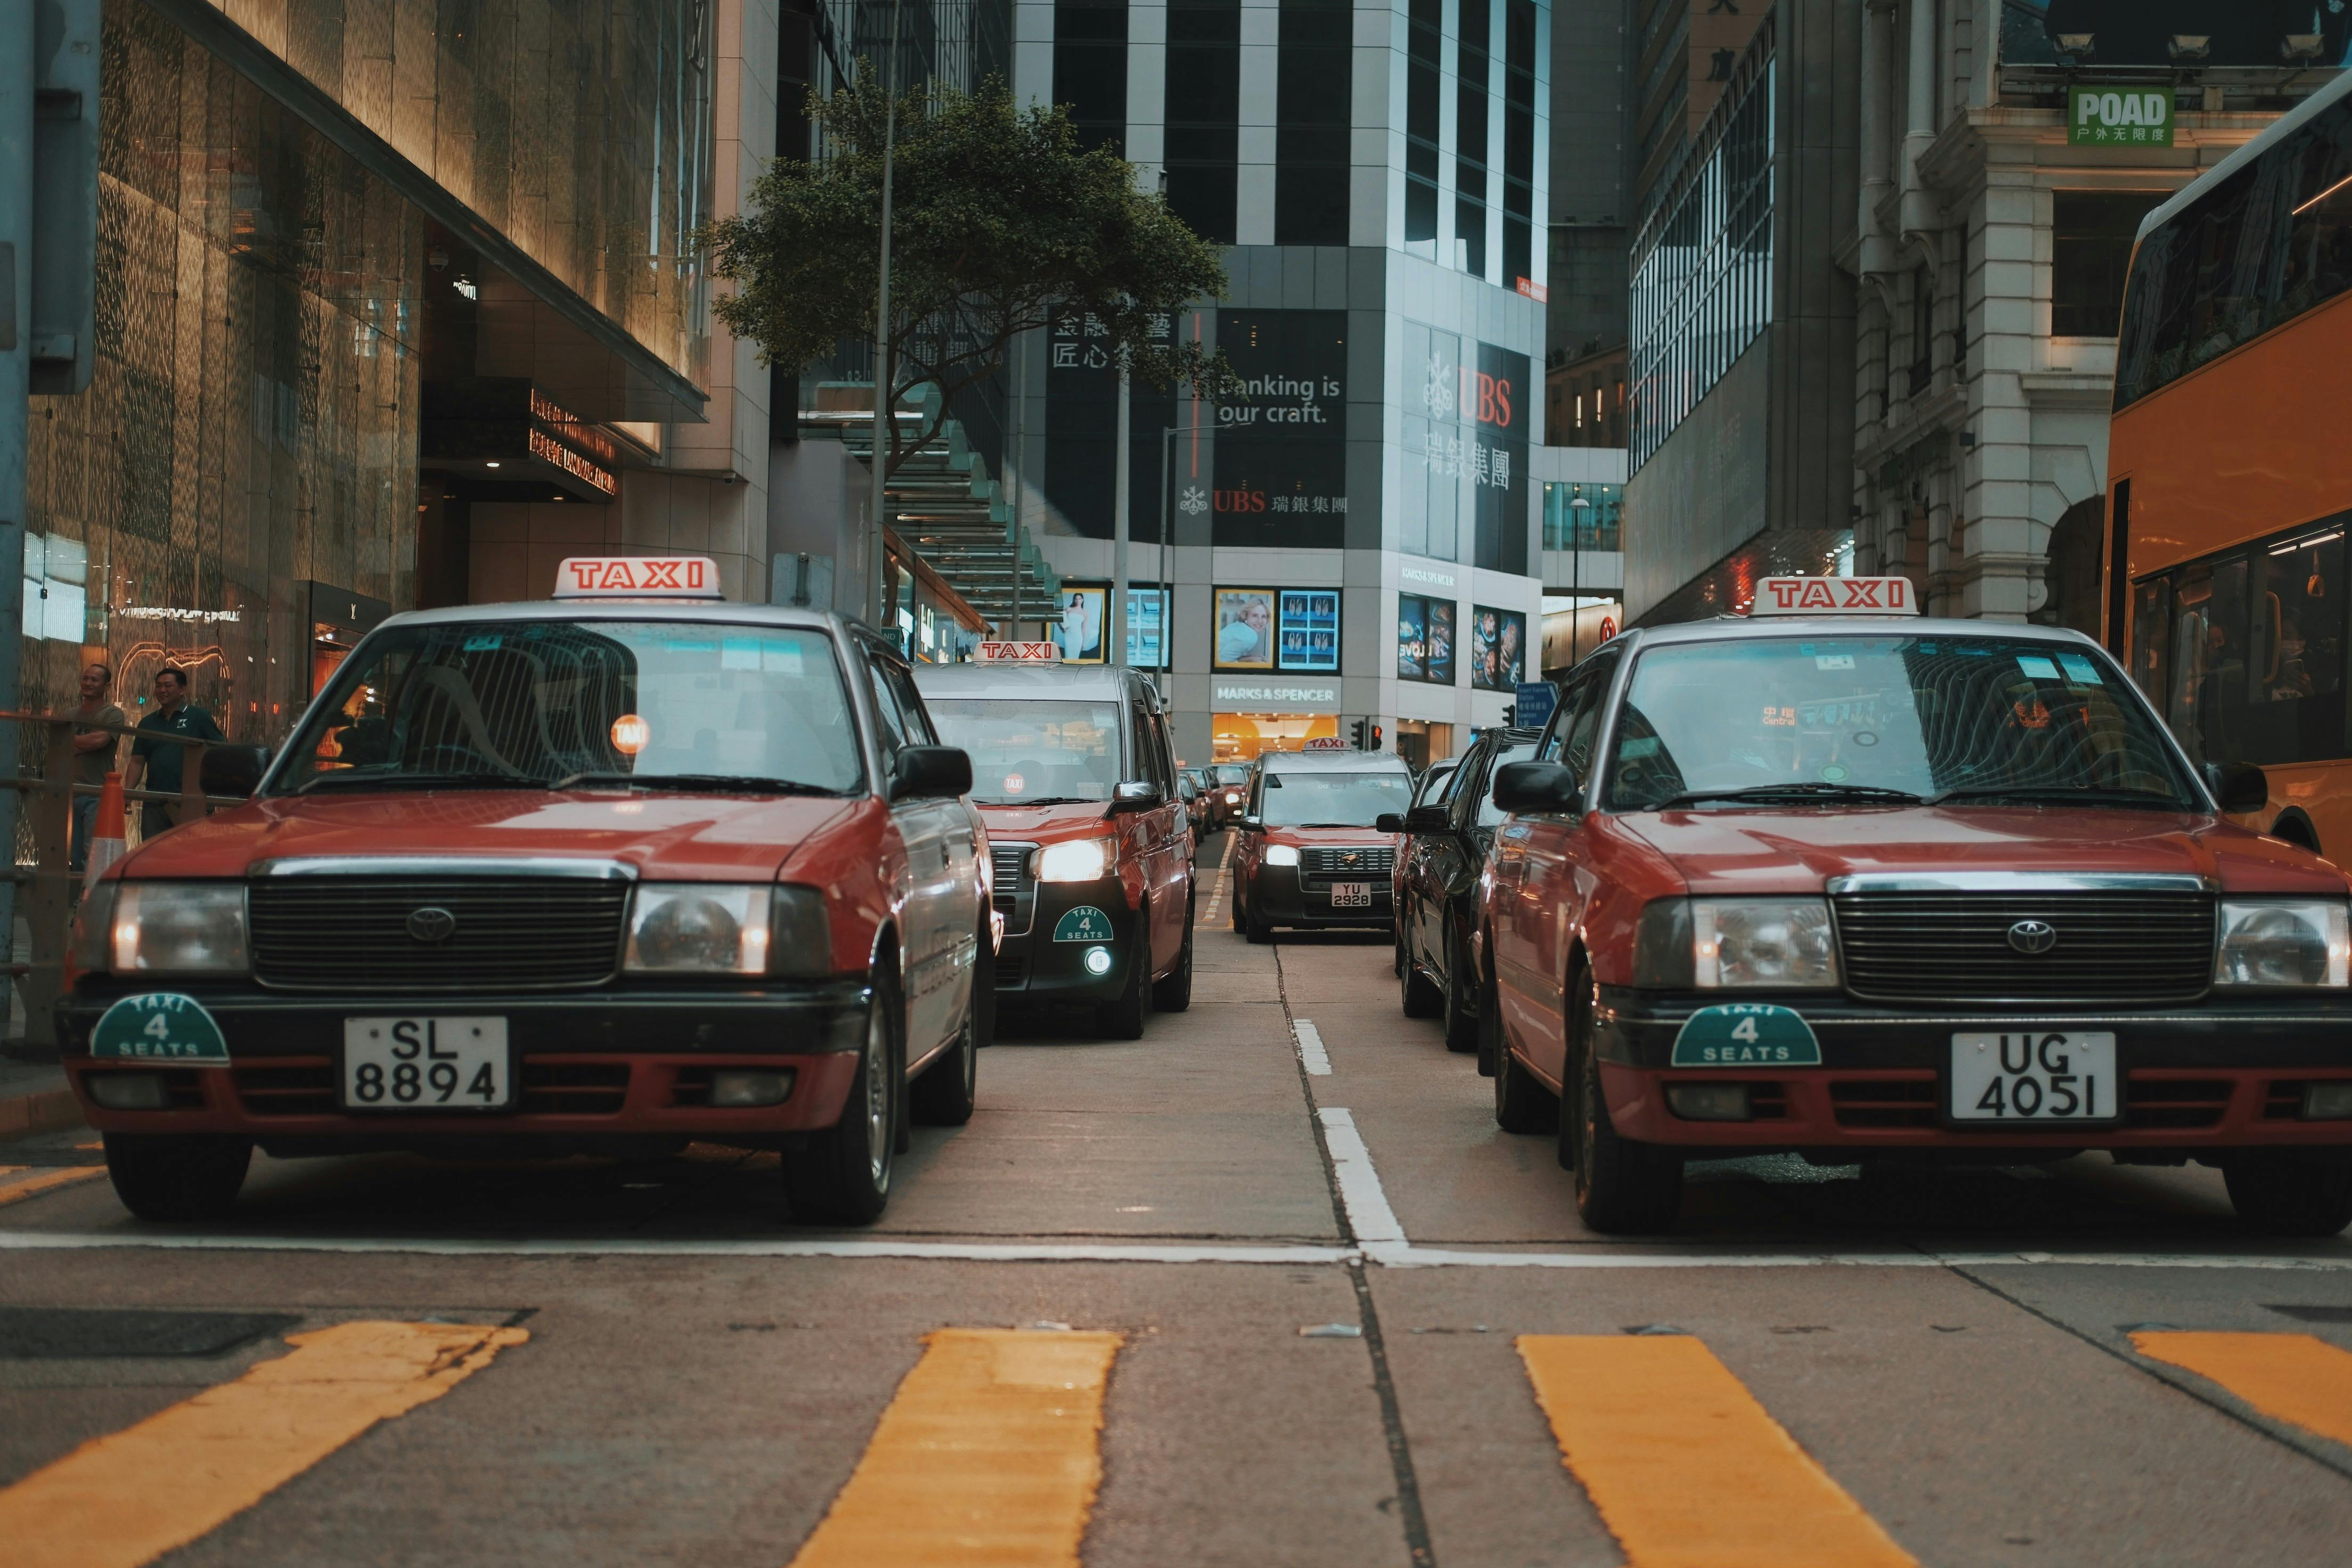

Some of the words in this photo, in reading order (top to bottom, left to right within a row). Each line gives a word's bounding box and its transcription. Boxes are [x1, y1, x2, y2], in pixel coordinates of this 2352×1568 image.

[2078, 93, 2166, 126] POAD
[1322, 375, 1340, 396] is
[1458, 366, 1511, 428] UBS
[1219, 406, 1260, 422] our
[1265, 401, 1327, 423] craft.
[1213, 490, 1265, 512] UBS
[1271, 495, 1348, 513] 瑞銀集團
[569, 561, 703, 589] TAXI
[1768, 580, 1904, 608] TAXI
[982, 642, 1052, 659] TAXI
[1218, 687, 1262, 700] MARKS
[1263, 688, 1273, 700] &
[1273, 688, 1334, 701] SPENCER
[1762, 716, 1795, 726] Central
[614, 724, 647, 744] TAXI
[1310, 738, 1344, 748] TAXI
[1005, 779, 1023, 789] TAXI
[1343, 884, 1360, 894] YU
[1334, 895, 1369, 905] 2928
[1072, 908, 1097, 917] TAXI
[1079, 917, 1091, 930] 4
[129, 995, 185, 1012] TAXI
[143, 1013, 169, 1040] 4
[1731, 1017, 1759, 1044] 4
[118, 1042, 199, 1057] SEATS
[391, 1019, 459, 1060] SL
[1703, 1046, 1790, 1061] SEATS
[1999, 1033, 2069, 1075] UG
[354, 1062, 495, 1103] 8894
[1975, 1075, 2095, 1117] 4051
